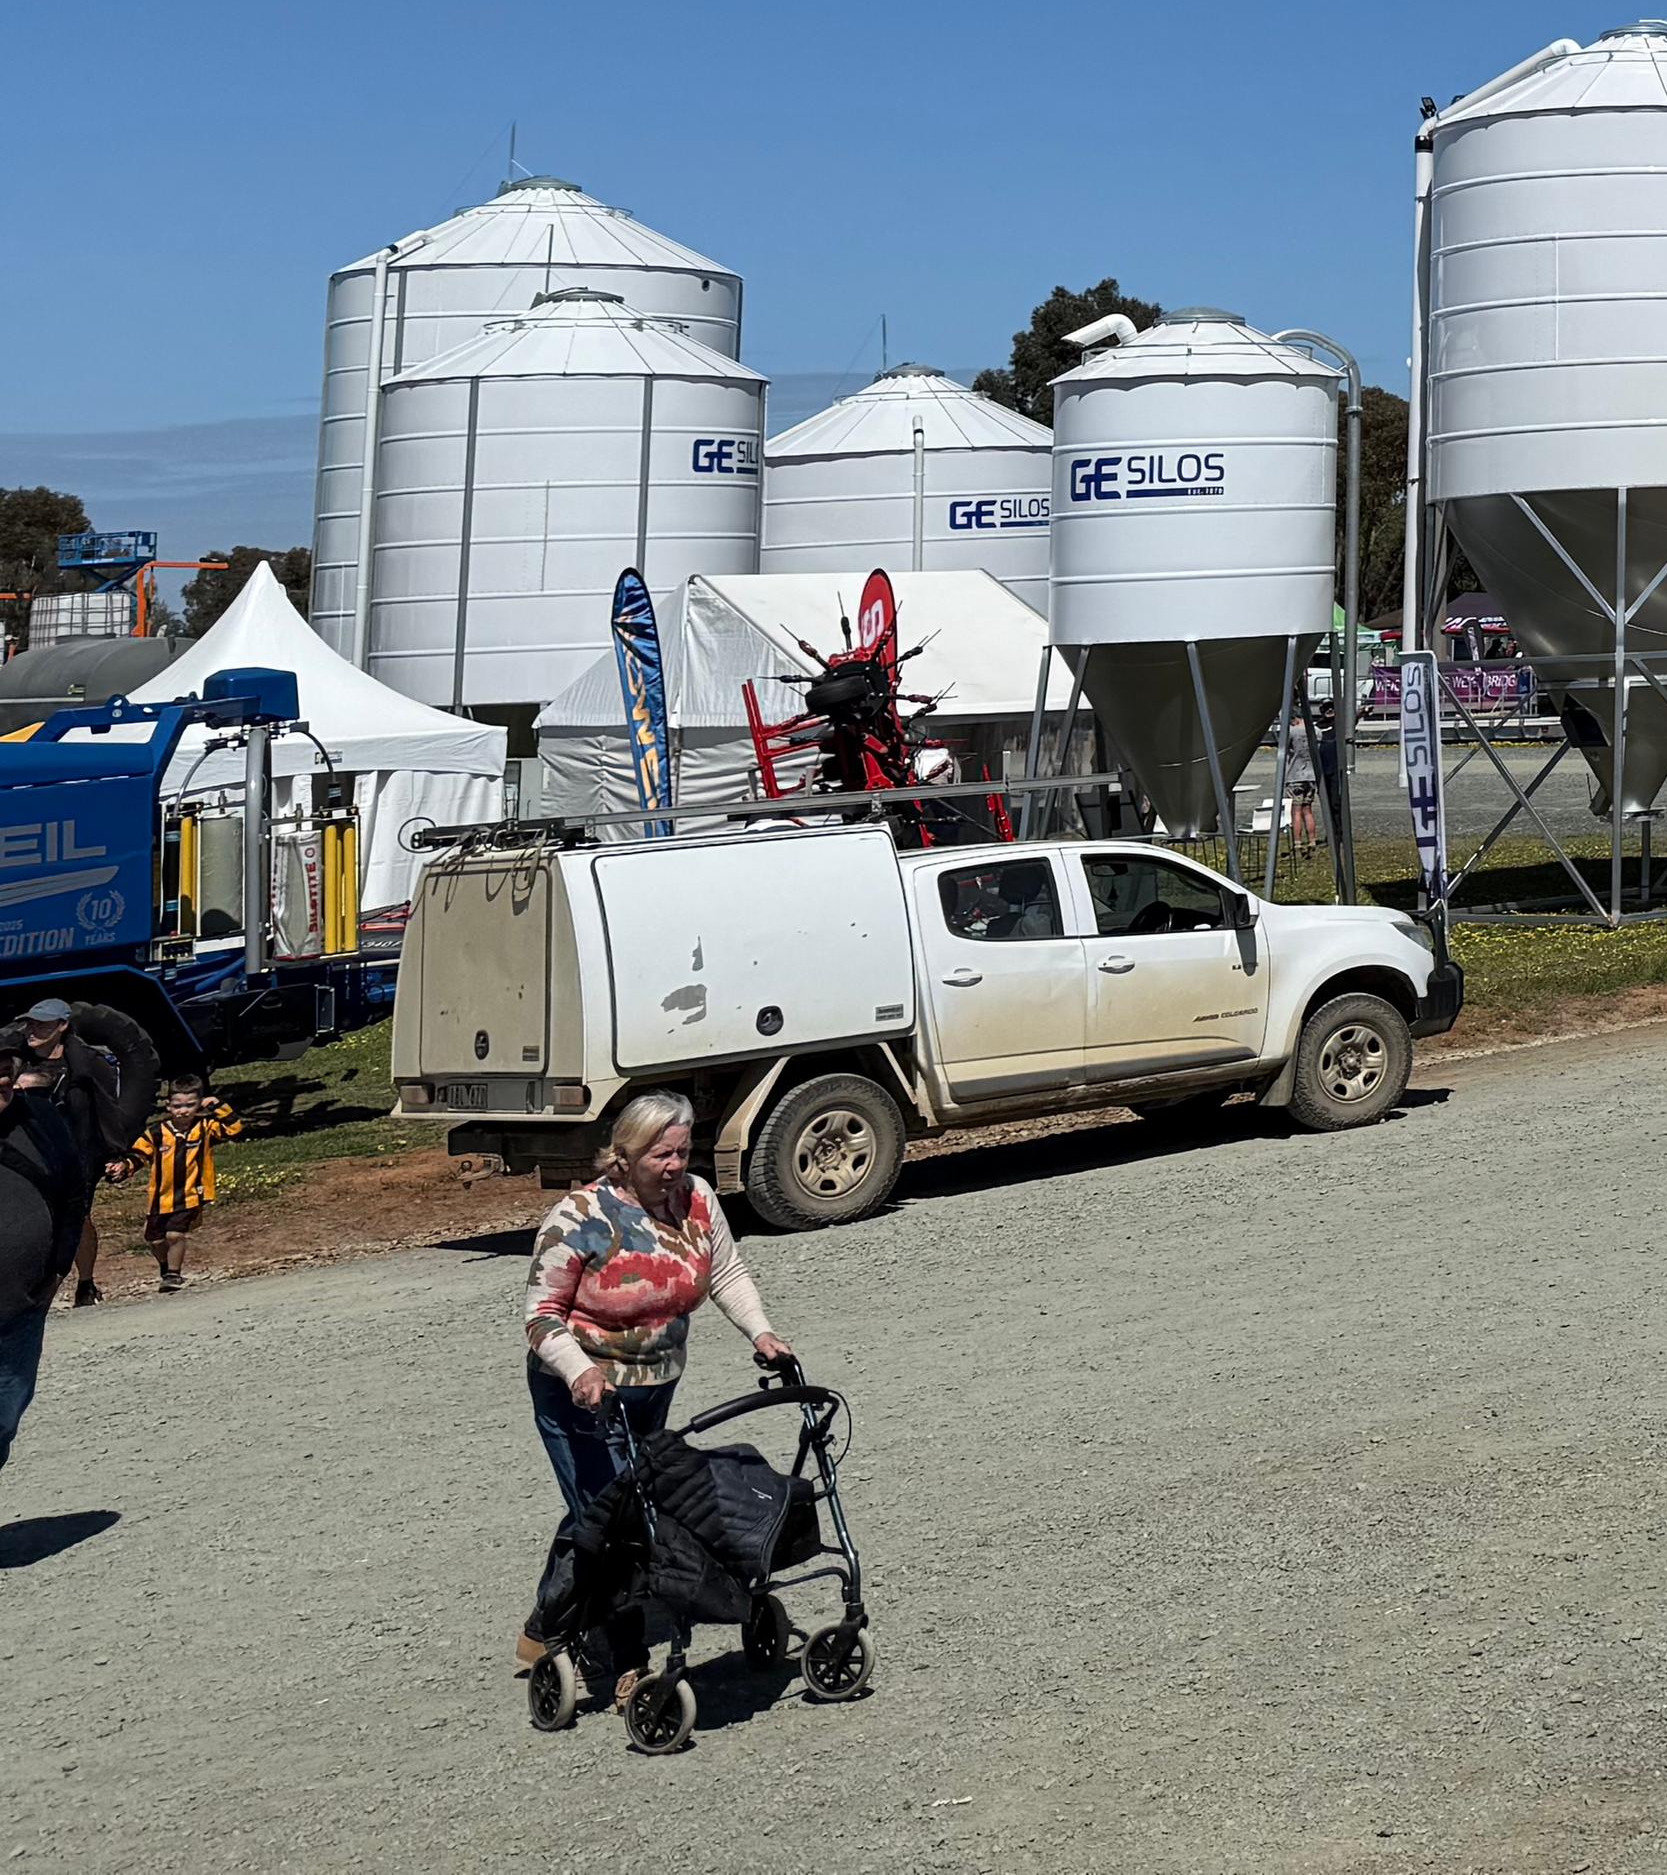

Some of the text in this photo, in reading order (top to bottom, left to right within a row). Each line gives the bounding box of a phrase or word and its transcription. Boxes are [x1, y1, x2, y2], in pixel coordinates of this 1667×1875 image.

[692, 438, 758, 473] GE SIL
[1071, 453, 1224, 502] GE SILOS
[950, 498, 1050, 530] GE SILOS
[1403, 665, 1428, 767] SILOS
[91, 898, 113, 921] 10
[0, 927, 75, 959] DITION
[85, 932, 116, 946] YEARS
